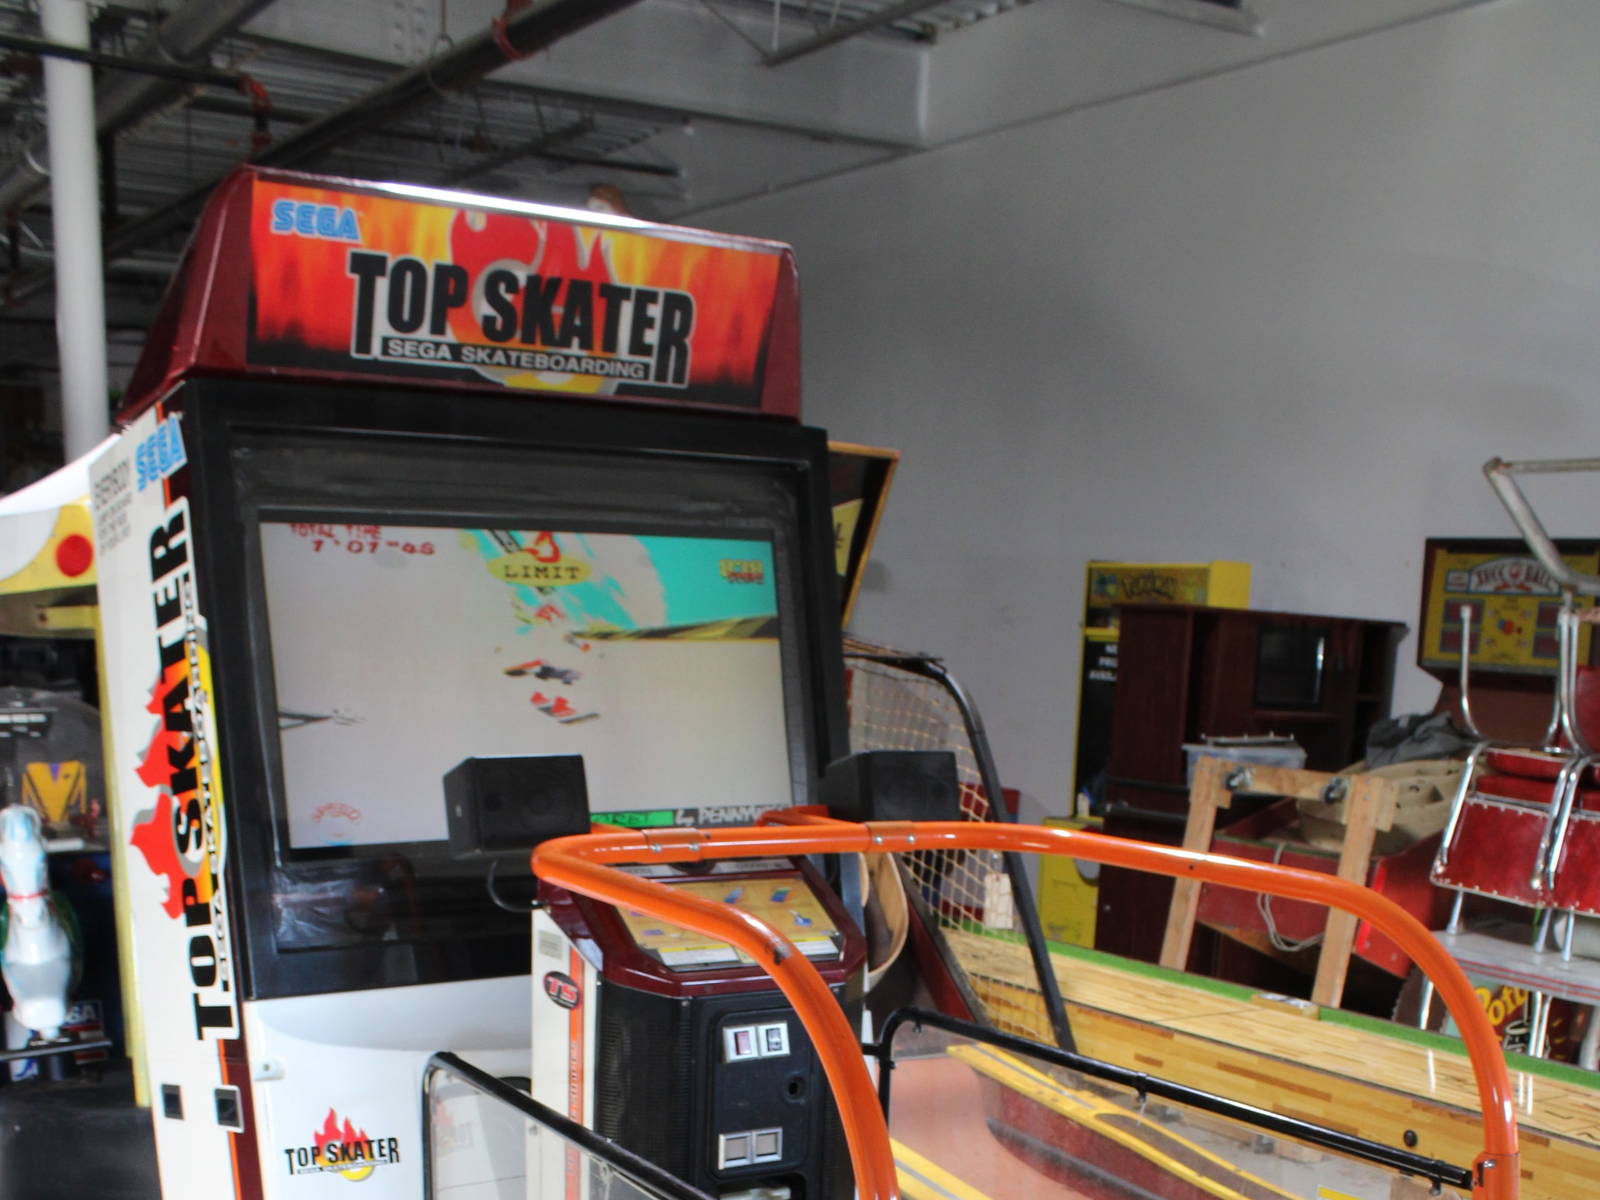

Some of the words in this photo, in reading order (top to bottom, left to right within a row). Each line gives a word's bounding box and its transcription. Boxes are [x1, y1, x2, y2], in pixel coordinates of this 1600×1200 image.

[272, 200, 360, 241] SEGA
[349, 250, 468, 357] TOP
[480, 269, 694, 386] SKATER
[387, 338, 453, 362] SEGA
[460, 345, 645, 380] SKATEBOARDING
[136, 414, 184, 492] SEGA
[503, 563, 580, 580] LIMIT
[150, 505, 204, 854] SKATER
[182, 877, 234, 1041] TOP
[547, 977, 577, 1001] TS
[284, 1145, 321, 1176] TOP
[326, 1137, 400, 1164] SKATER
